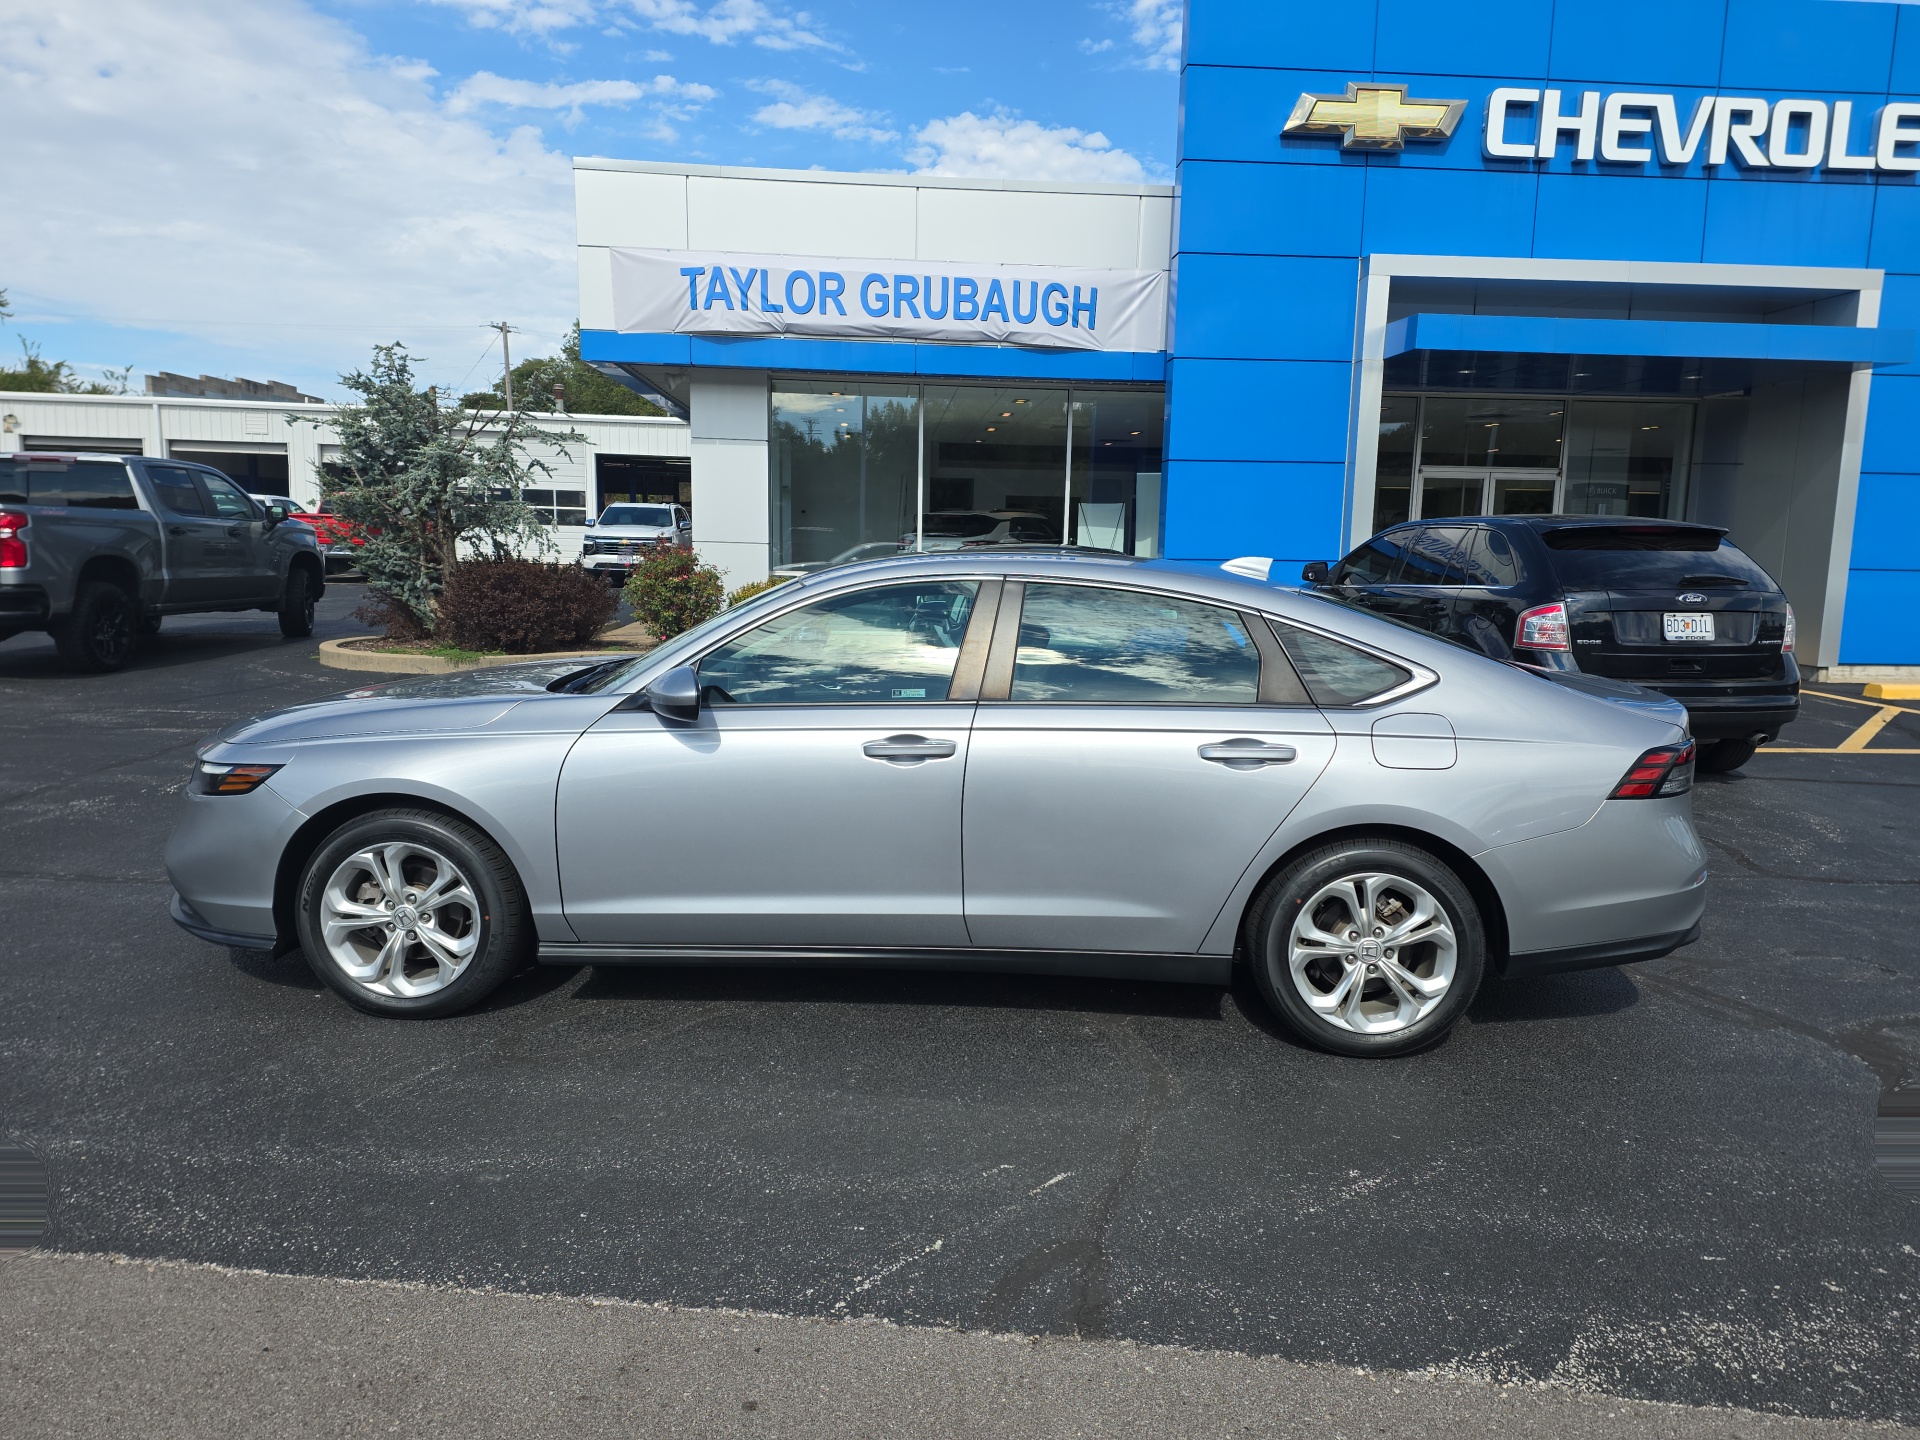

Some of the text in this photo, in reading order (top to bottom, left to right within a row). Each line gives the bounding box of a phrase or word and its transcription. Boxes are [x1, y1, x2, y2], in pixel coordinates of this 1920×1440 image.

[1484, 88, 1919, 171] CHEVROLE
[680, 266, 1098, 330] TAYLOR GRUBAUGH
[1596, 487, 1617, 495] BUICK
[1667, 619, 1685, 633] BD3
